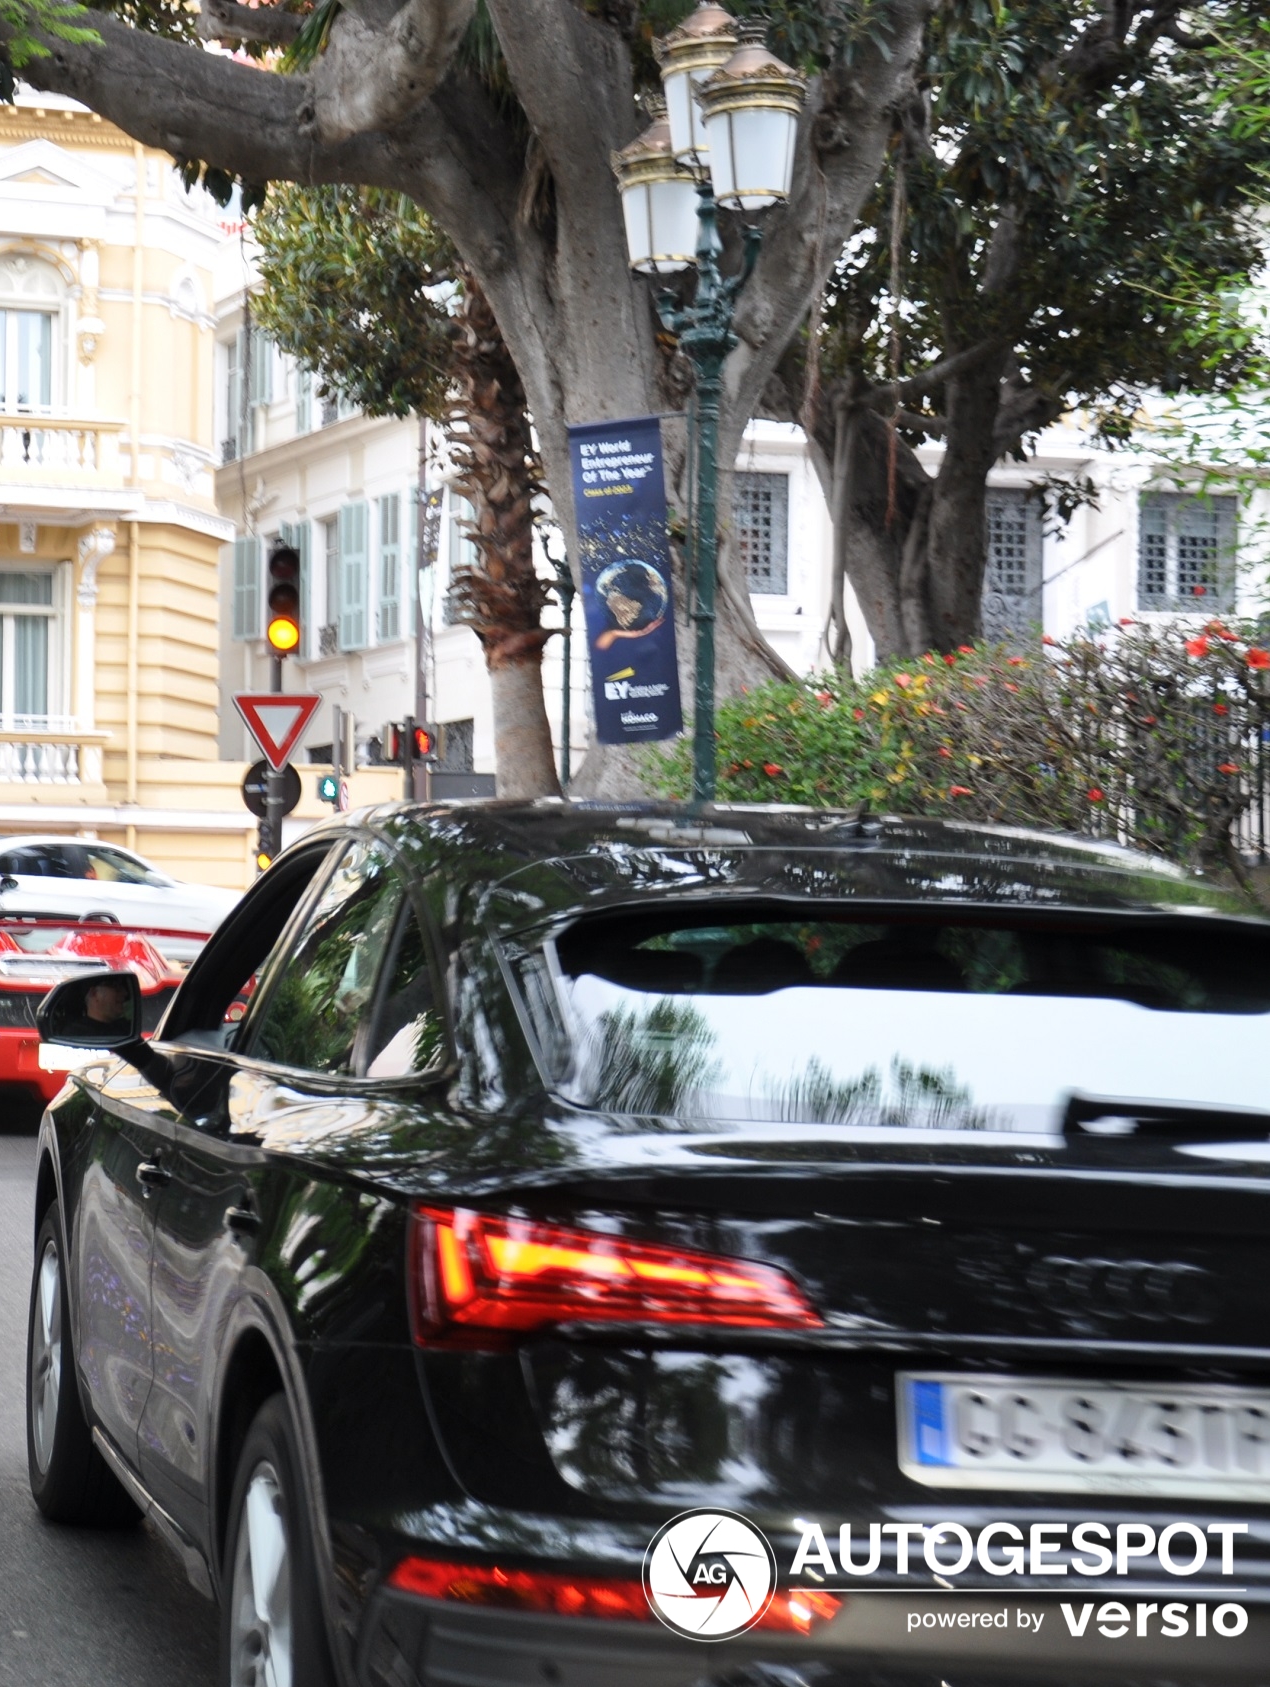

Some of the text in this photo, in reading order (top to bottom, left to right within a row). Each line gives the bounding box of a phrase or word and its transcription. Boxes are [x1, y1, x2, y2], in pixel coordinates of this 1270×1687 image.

[580, 440, 632, 456] EY World
[581, 453, 655, 470] Entrepreneur
[582, 470, 598, 483] Of
[598, 469, 622, 482] The
[604, 681, 630, 700] EY
